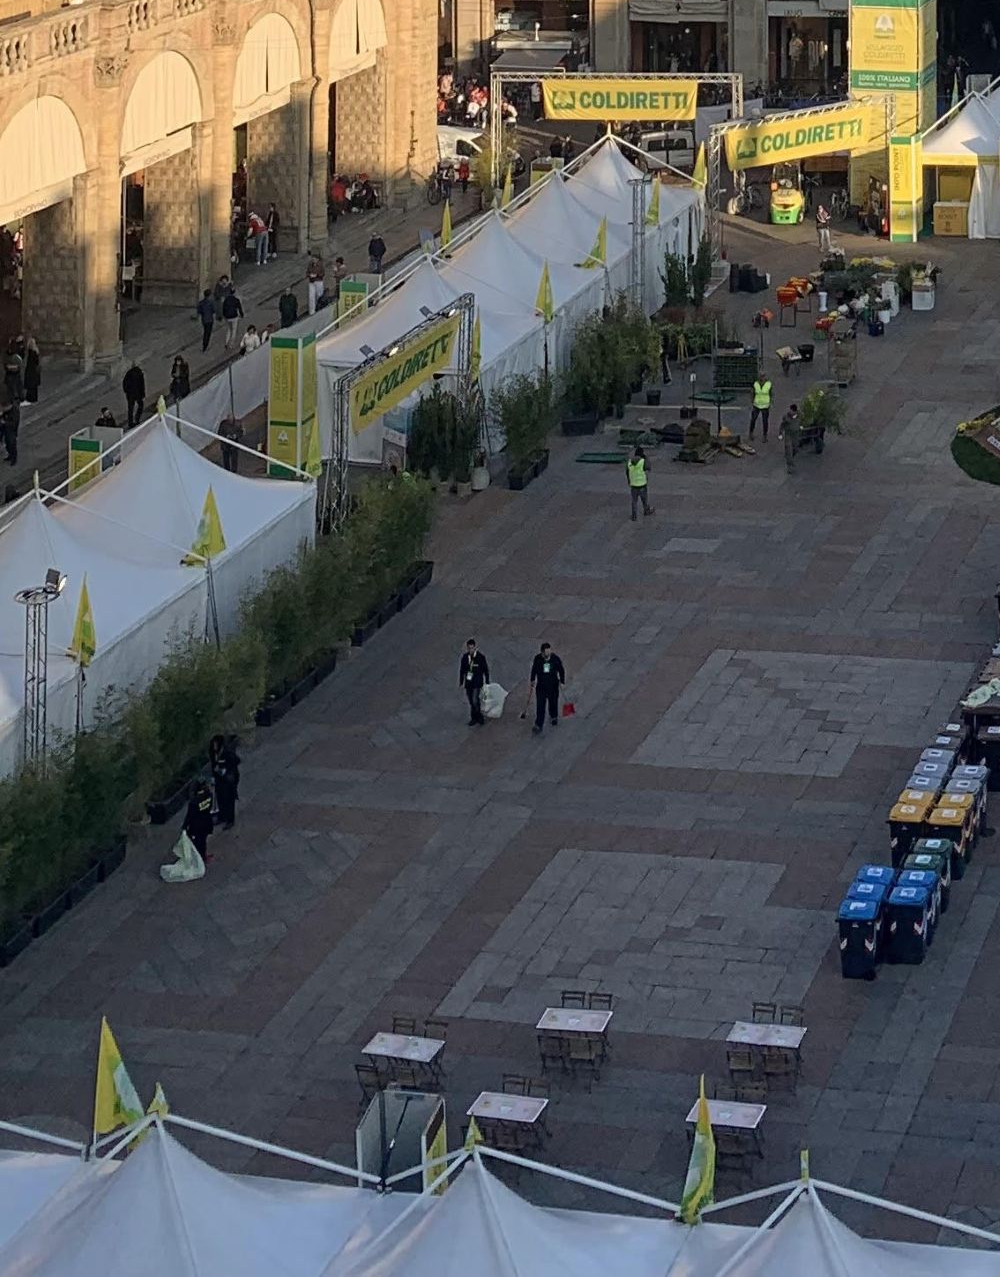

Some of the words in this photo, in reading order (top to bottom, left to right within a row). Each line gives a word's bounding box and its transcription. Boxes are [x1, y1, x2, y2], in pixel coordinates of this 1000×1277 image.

[877, 74, 911, 83] ITALIANO
[579, 90, 689, 110] COLDIRETTI
[760, 118, 863, 153] COLDIRETTI
